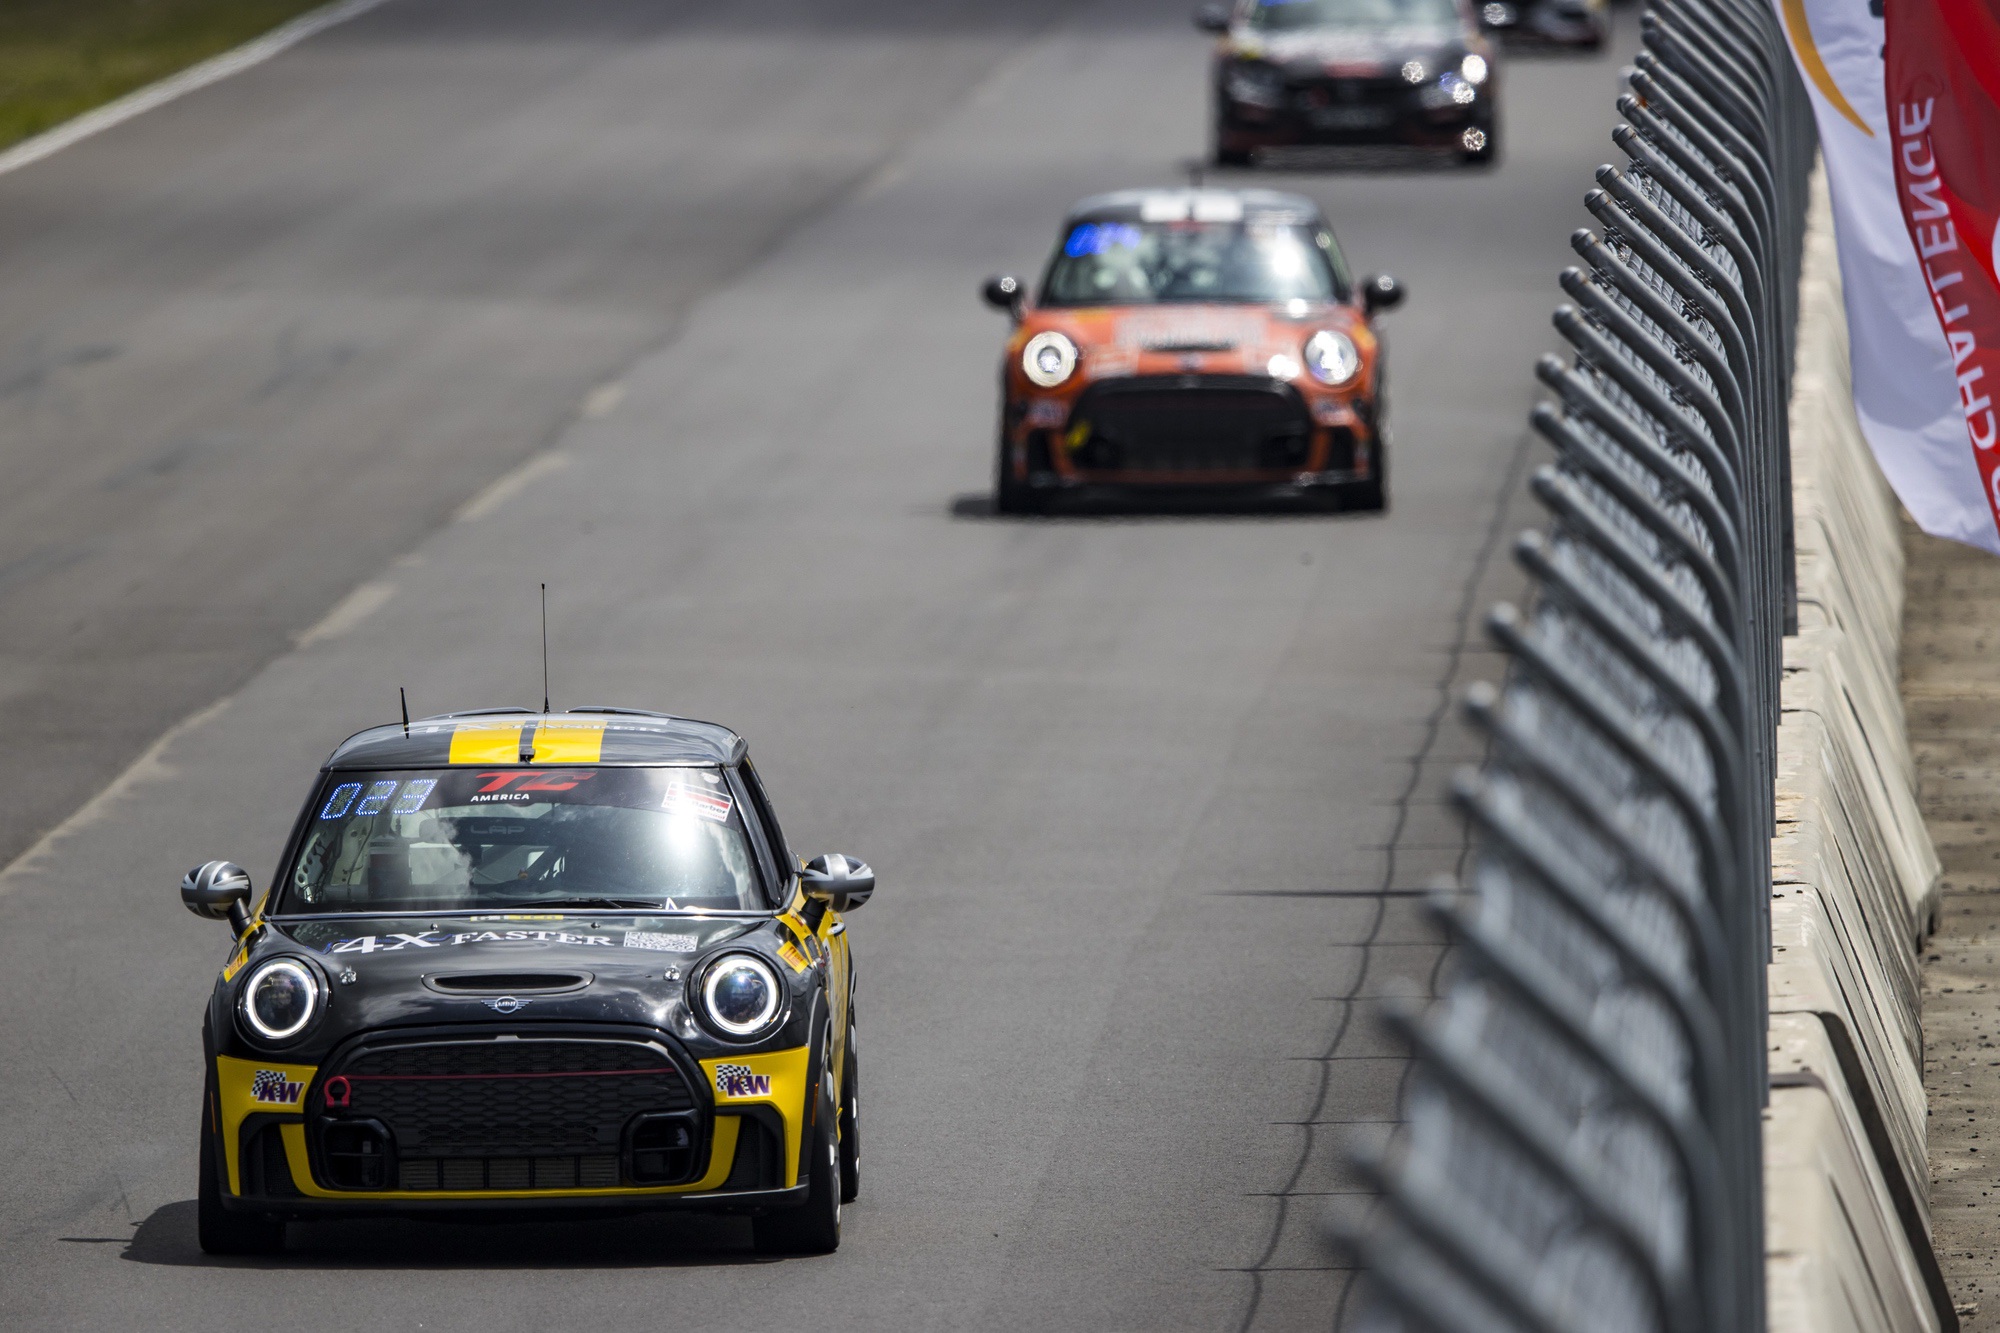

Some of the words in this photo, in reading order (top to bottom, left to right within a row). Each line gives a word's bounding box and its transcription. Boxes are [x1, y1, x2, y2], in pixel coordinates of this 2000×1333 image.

[475, 771, 597, 792] TC
[320, 779, 439, 819] 023
[470, 793, 530, 802] AMERICA
[334, 930, 440, 954] 4X
[451, 931, 615, 946] FASTER
[257, 1080, 305, 1102] KW
[727, 1075, 770, 1097] KW
